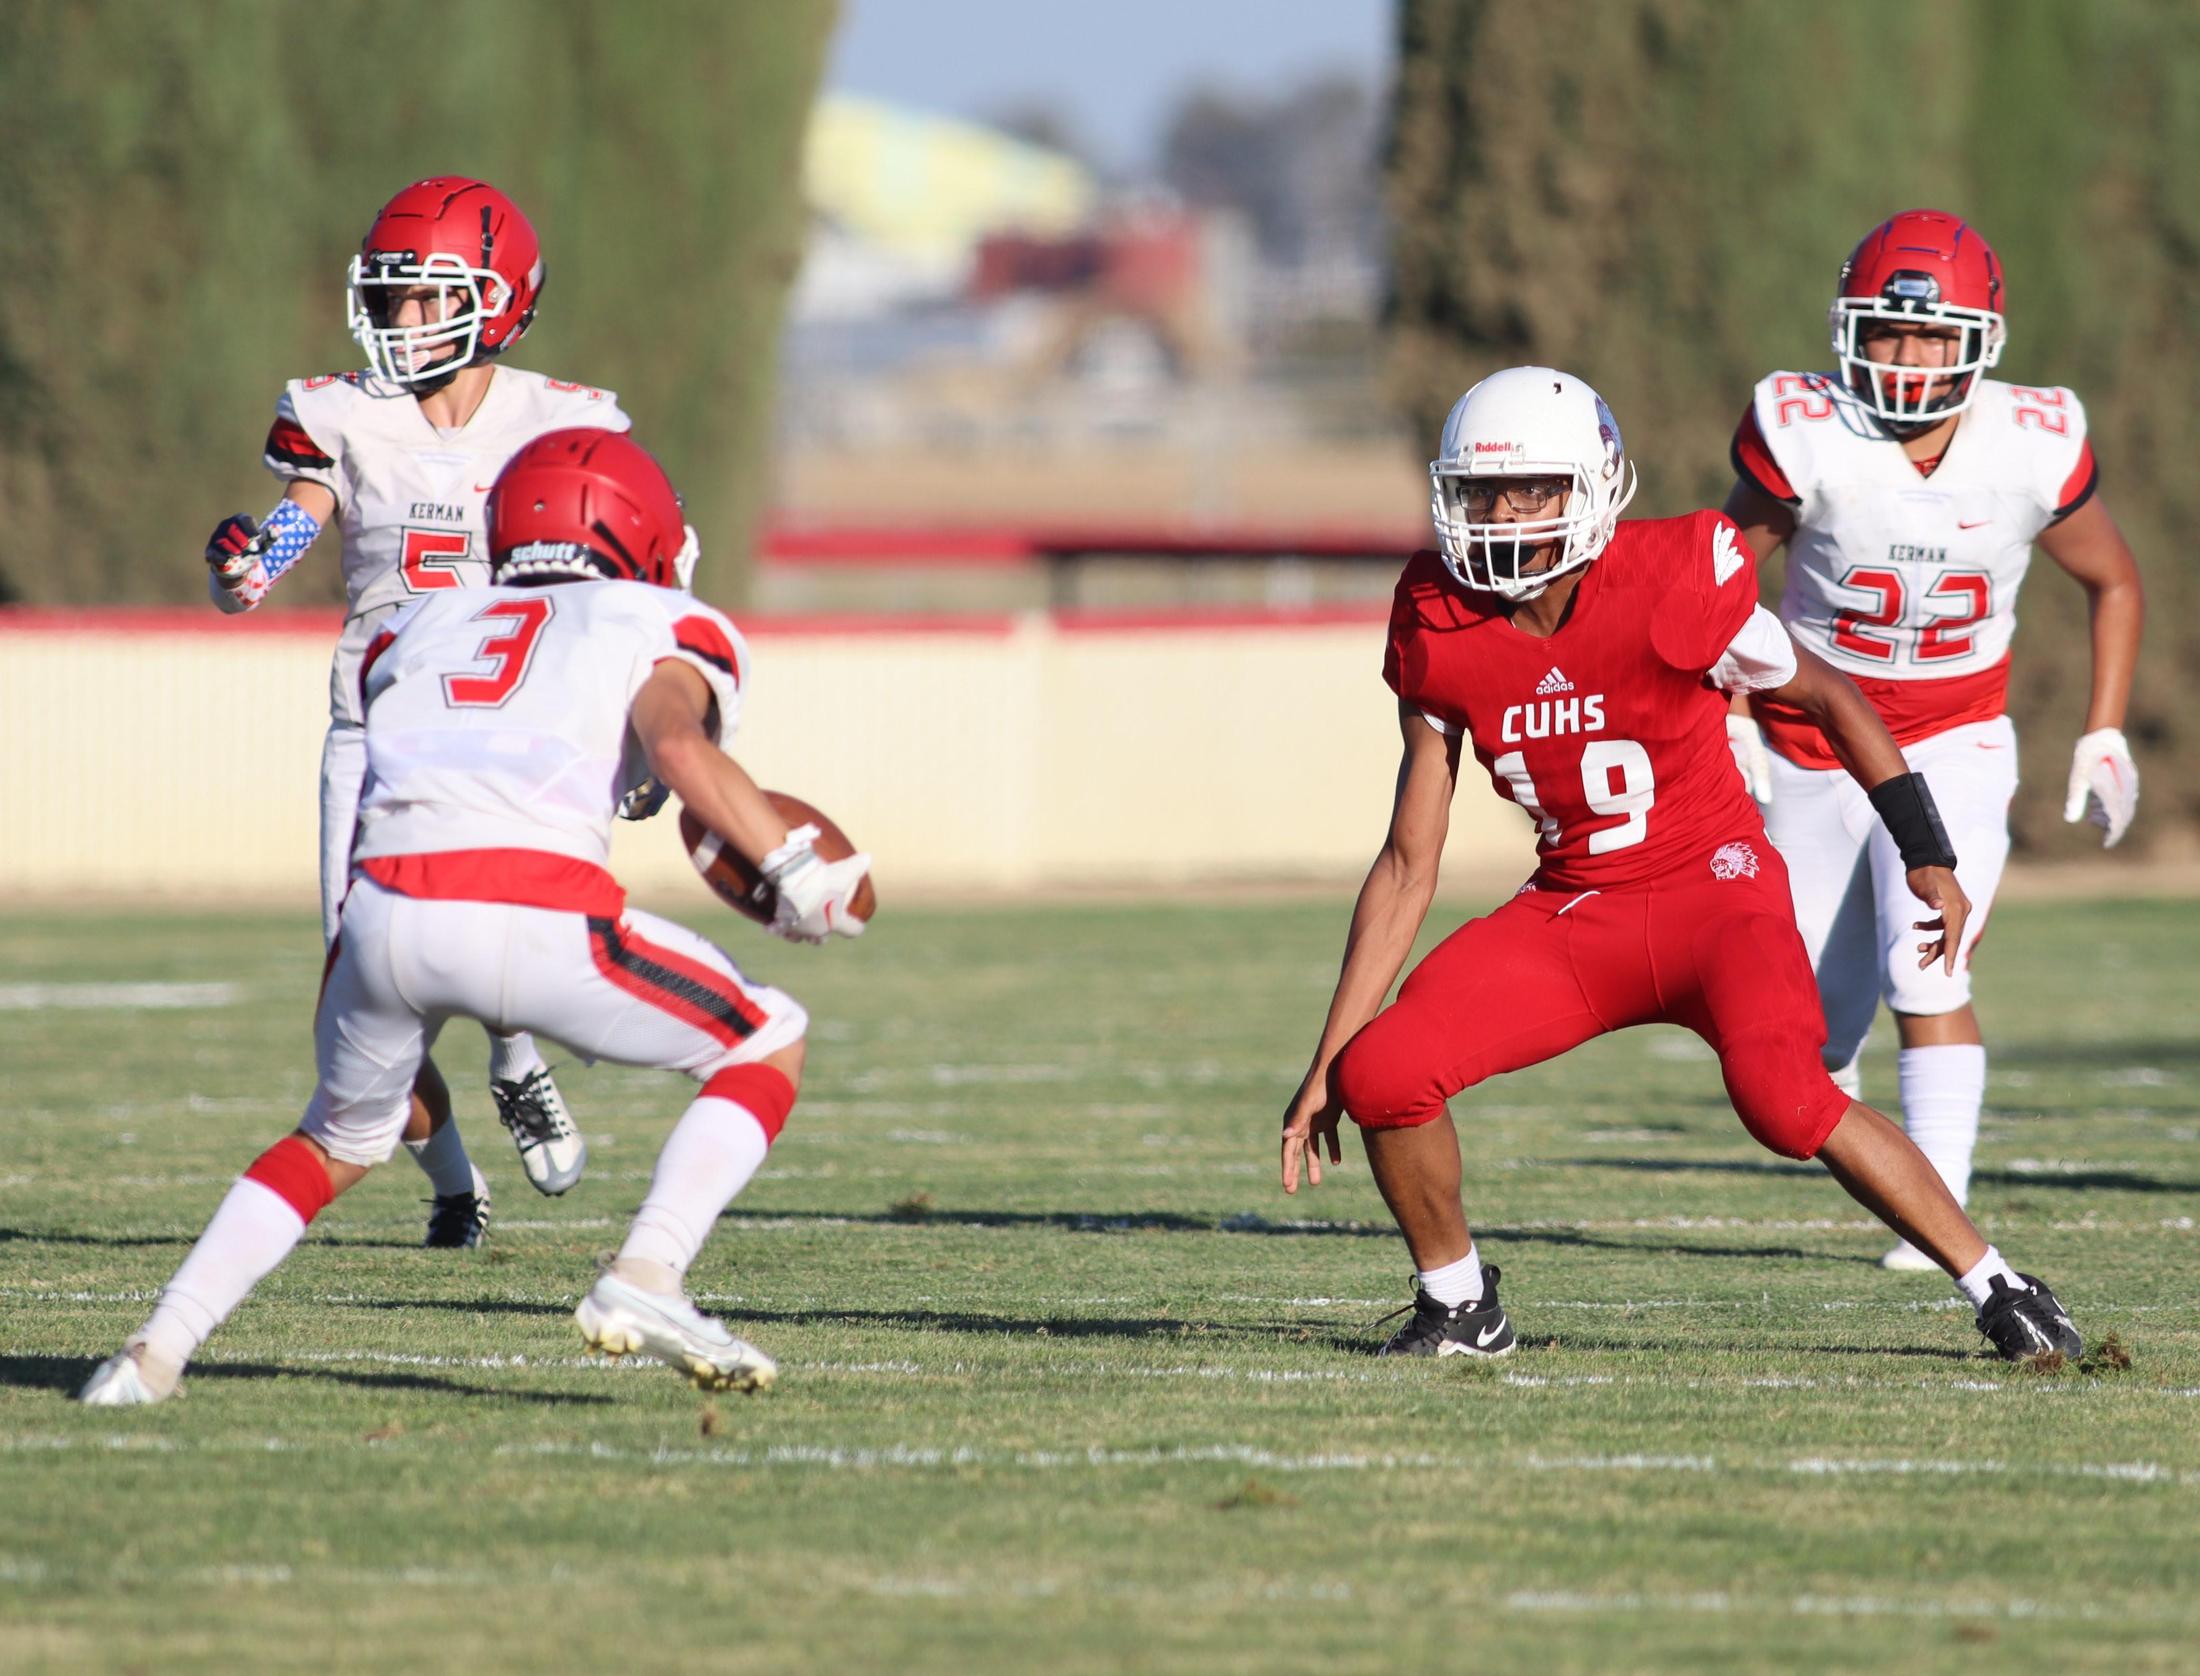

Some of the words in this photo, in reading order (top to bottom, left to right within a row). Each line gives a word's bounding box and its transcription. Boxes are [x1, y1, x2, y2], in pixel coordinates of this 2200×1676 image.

[1474, 441, 1511, 453] Riddell
[408, 502, 464, 523] KERMAN
[399, 525, 472, 595] 5
[510, 540, 578, 563] schutt
[1888, 544, 1948, 563] KERMAN
[1828, 564, 1995, 665] 22
[440, 595, 557, 709] 3
[1535, 681, 1575, 695] adidas
[1501, 694, 1606, 743] CUHS
[1493, 738, 1656, 856] 19
